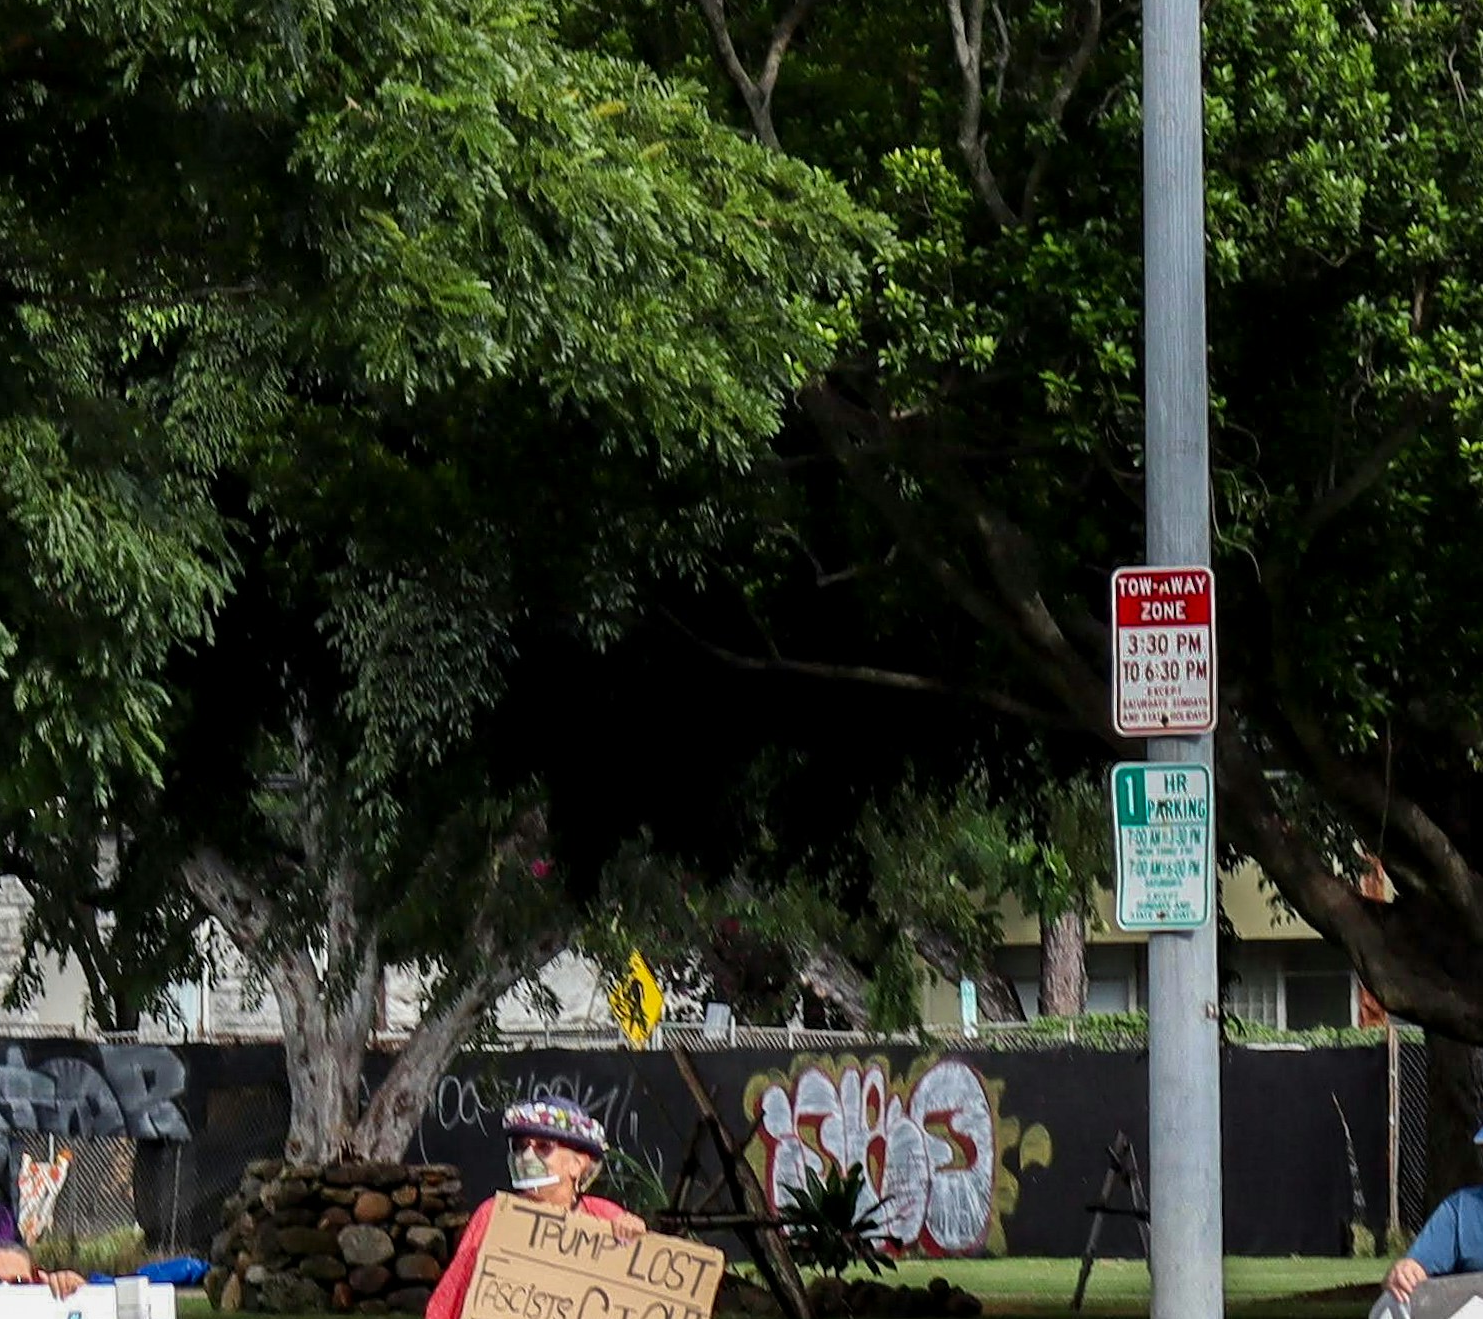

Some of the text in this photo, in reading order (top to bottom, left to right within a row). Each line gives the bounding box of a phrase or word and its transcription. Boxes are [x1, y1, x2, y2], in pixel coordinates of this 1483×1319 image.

[1118, 575, 1207, 597] TOW-AWAY
[1141, 600, 1187, 620] ZONE
[1128, 633, 1201, 655] 3:30 PM
[1123, 660, 1207, 682] TO 6:30 PM
[1164, 773, 1188, 793] HR
[1124, 774, 1135, 816] 1
[1148, 798, 1207, 821] PARKING
[512, 1204, 717, 1299] TRUMP LOST
